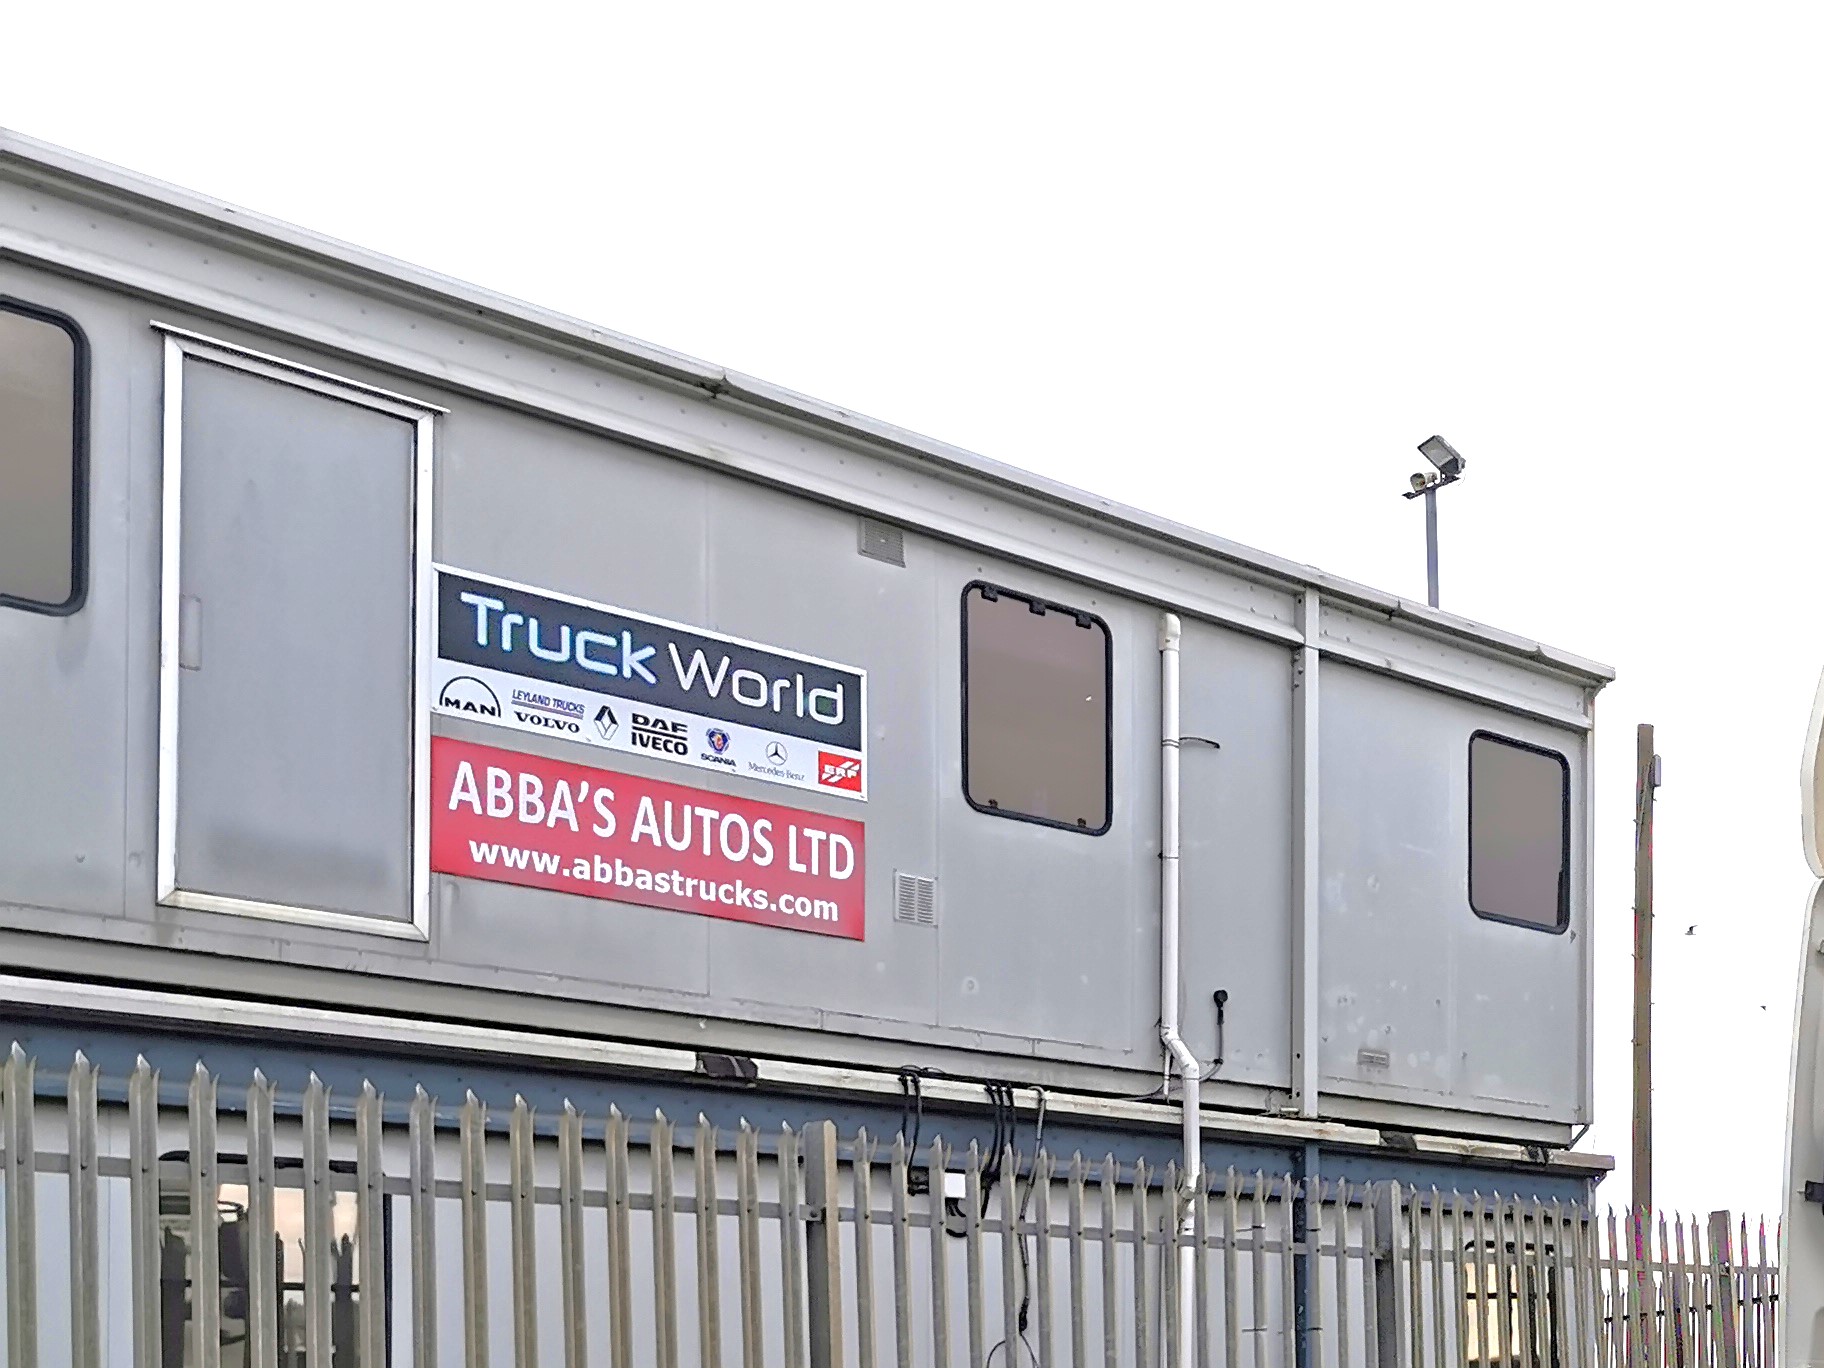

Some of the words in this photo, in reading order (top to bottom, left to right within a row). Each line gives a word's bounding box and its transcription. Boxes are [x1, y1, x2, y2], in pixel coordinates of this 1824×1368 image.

[460, 591, 658, 685] Truck
[668, 642, 845, 726] World
[444, 697, 496, 717] MAN
[511, 688, 550, 706] LEYLAND
[552, 697, 586, 715] TRUCKS
[513, 711, 580, 733] VOLVO
[631, 712, 688, 733] DAF
[631, 732, 688, 756] IVECO
[700, 752, 737, 768] SCANIA
[449, 760, 616, 839] ABBA'S
[631, 796, 774, 867] AUTOS
[788, 824, 855, 880] LTD
[469, 839, 839, 922] www.abbastrucks.com
